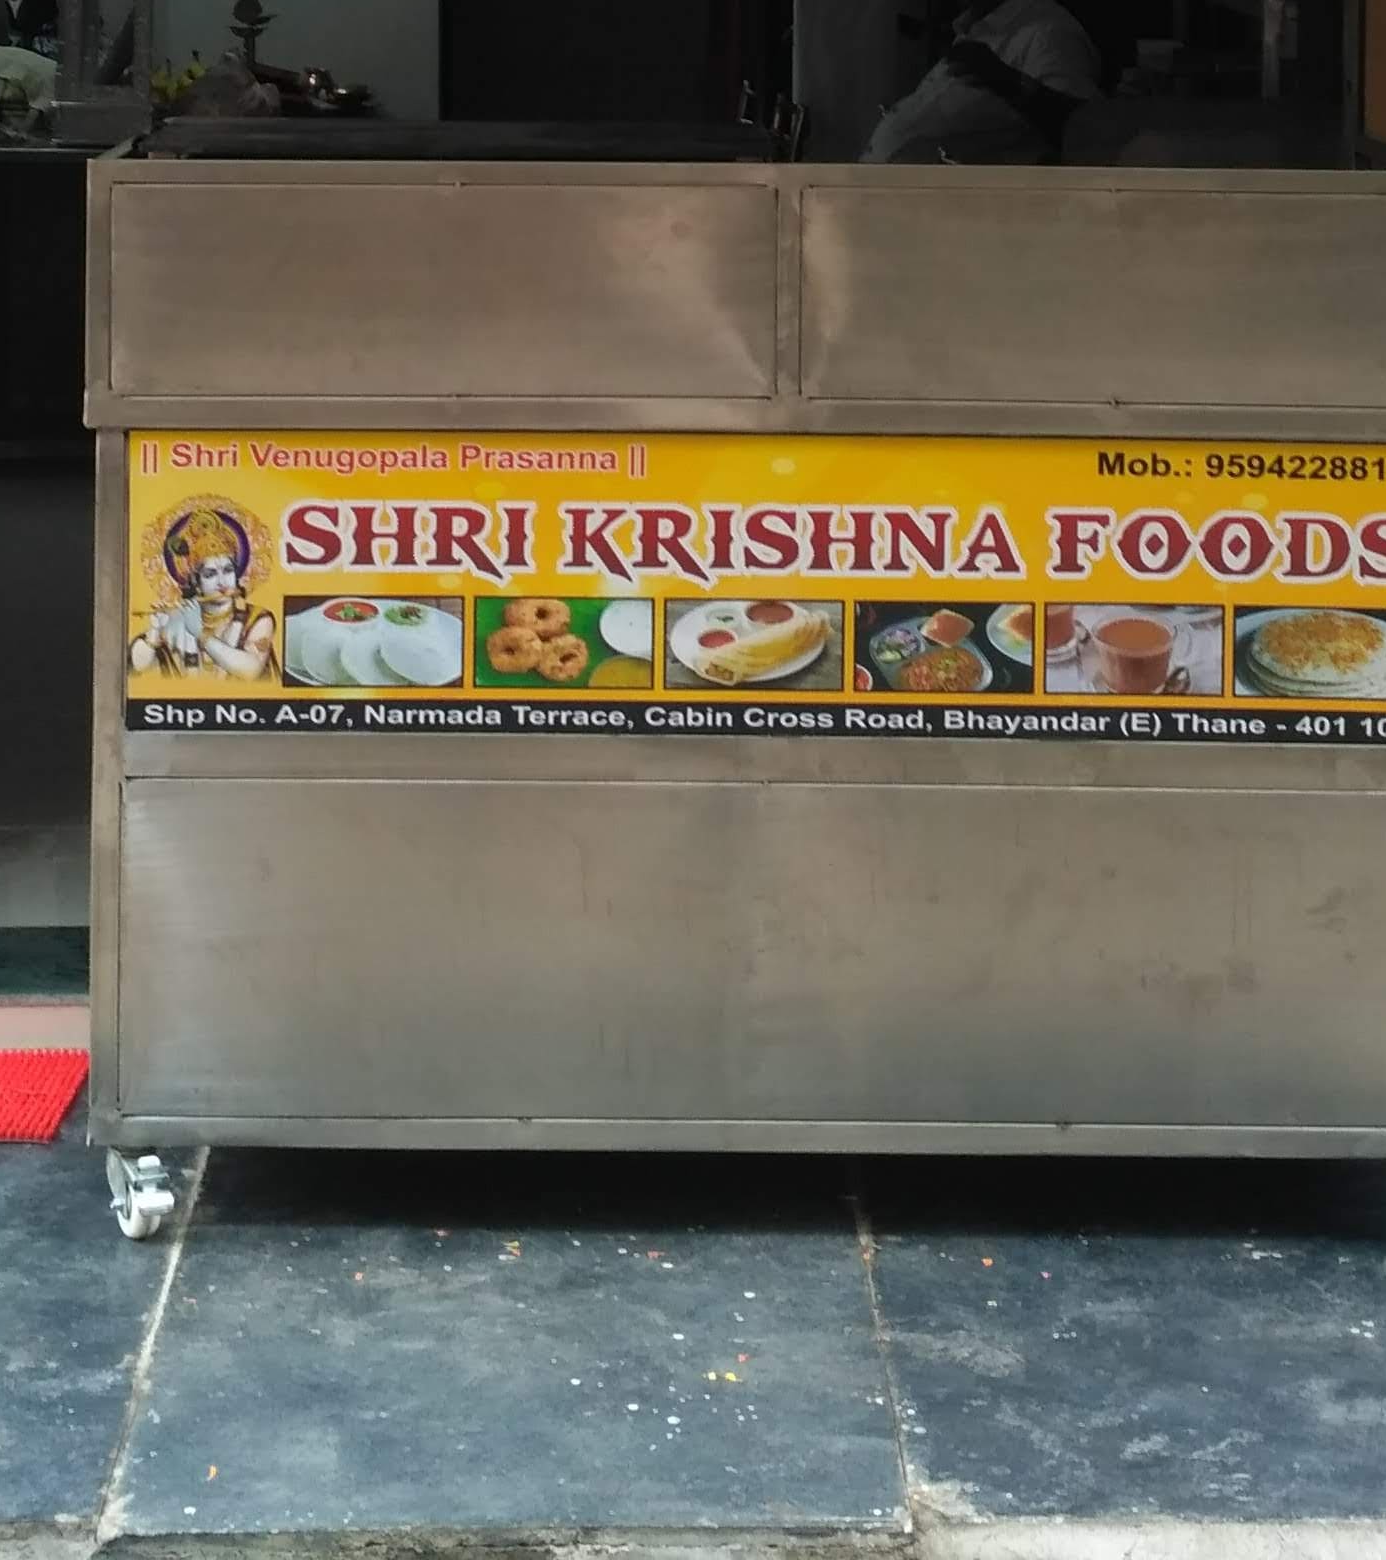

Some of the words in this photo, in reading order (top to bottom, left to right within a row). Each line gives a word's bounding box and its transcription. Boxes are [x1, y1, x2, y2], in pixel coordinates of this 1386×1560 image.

[171, 443, 238, 468] Shri
[250, 444, 449, 475] Venugopala
[459, 445, 618, 471] Prasanna
[1097, 451, 1193, 478] Mob.:
[282, 500, 533, 585] SHRI
[561, 501, 1026, 590] KRISHNA
[143, 703, 205, 726] Shp
[215, 704, 266, 725] No.
[274, 704, 355, 728] A-07,
[363, 704, 503, 726] Narmada
[511, 705, 635, 730] Terrace,
[643, 706, 734, 728] Cabin
[743, 707, 834, 729] Cross
[844, 708, 933, 733] Road,
[943, 709, 1112, 736] Bhayandar
[1118, 711, 1162, 737] (E)
[1171, 712, 1267, 735] Thane
[1294, 716, 1347, 736] 401
